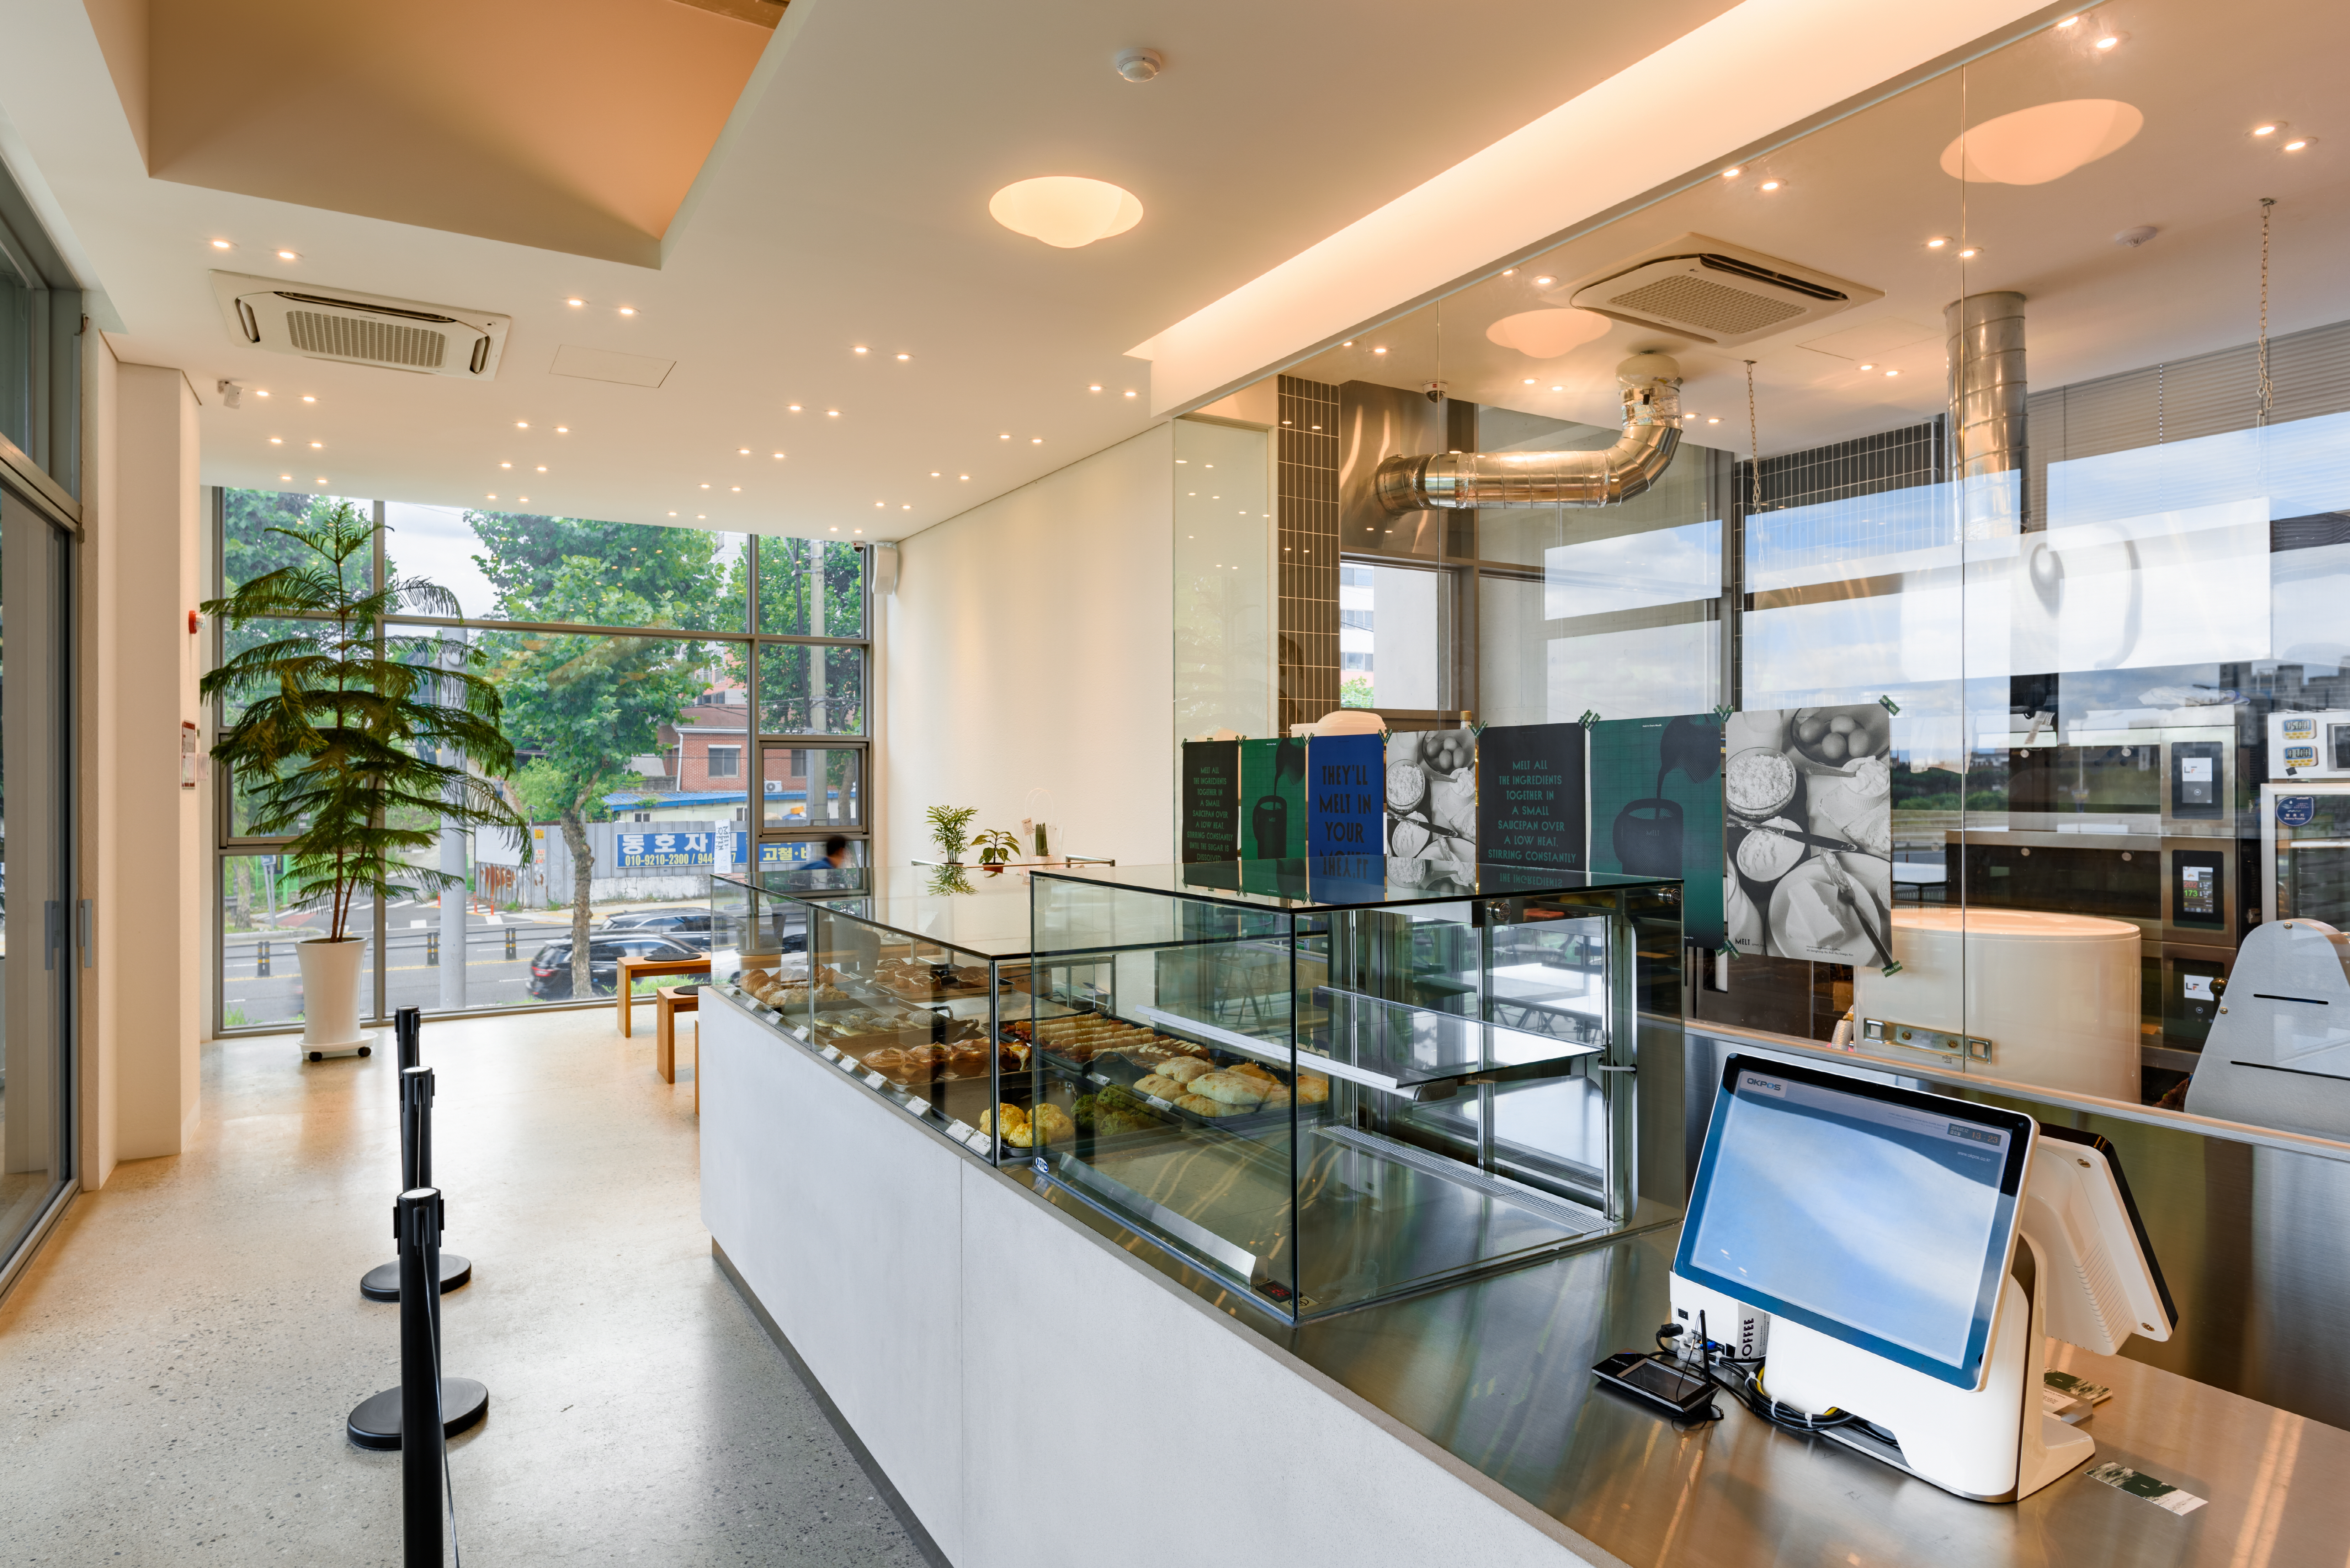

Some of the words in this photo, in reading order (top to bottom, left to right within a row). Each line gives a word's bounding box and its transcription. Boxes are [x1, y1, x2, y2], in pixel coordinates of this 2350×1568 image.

[1888, 704, 1897, 713] MELT
[1513, 761, 1530, 770] MELT
[1533, 760, 1547, 769] ALL
[1322, 764, 1368, 785] THEY'LL
[1499, 776, 1509, 785] THE
[1513, 775, 1562, 785] INGREDIENTS
[1506, 790, 1543, 800] TOGETHER
[1547, 790, 1554, 800] IN
[1319, 793, 1350, 814] MELT
[1358, 794, 1371, 815] IN
[1512, 806, 1519, 815] A
[1522, 806, 1549, 815] SMALL
[1498, 820, 1538, 830] SAUCEPAN
[1541, 821, 1565, 831] OVER
[1207, 832, 1233, 841] CONSTANTLY
[1325, 821, 1365, 843] YOUR
[1504, 835, 1511, 844] A
[1514, 835, 1534, 845] LOW
[1538, 836, 1558, 848] HEAT,
[625, 854, 689, 866] 010-9210-2300
[698, 853, 736, 864] 944-7
[1488, 849, 1522, 860] STIRRING
[1525, 851, 1576, 863] CONSTANTLY
[1747, 1078, 1781, 1091] OKPOS
[1957, 1151, 1991, 1163] www.okpos.co.kr
[1742, 1318, 1754, 1359] OFFEE
